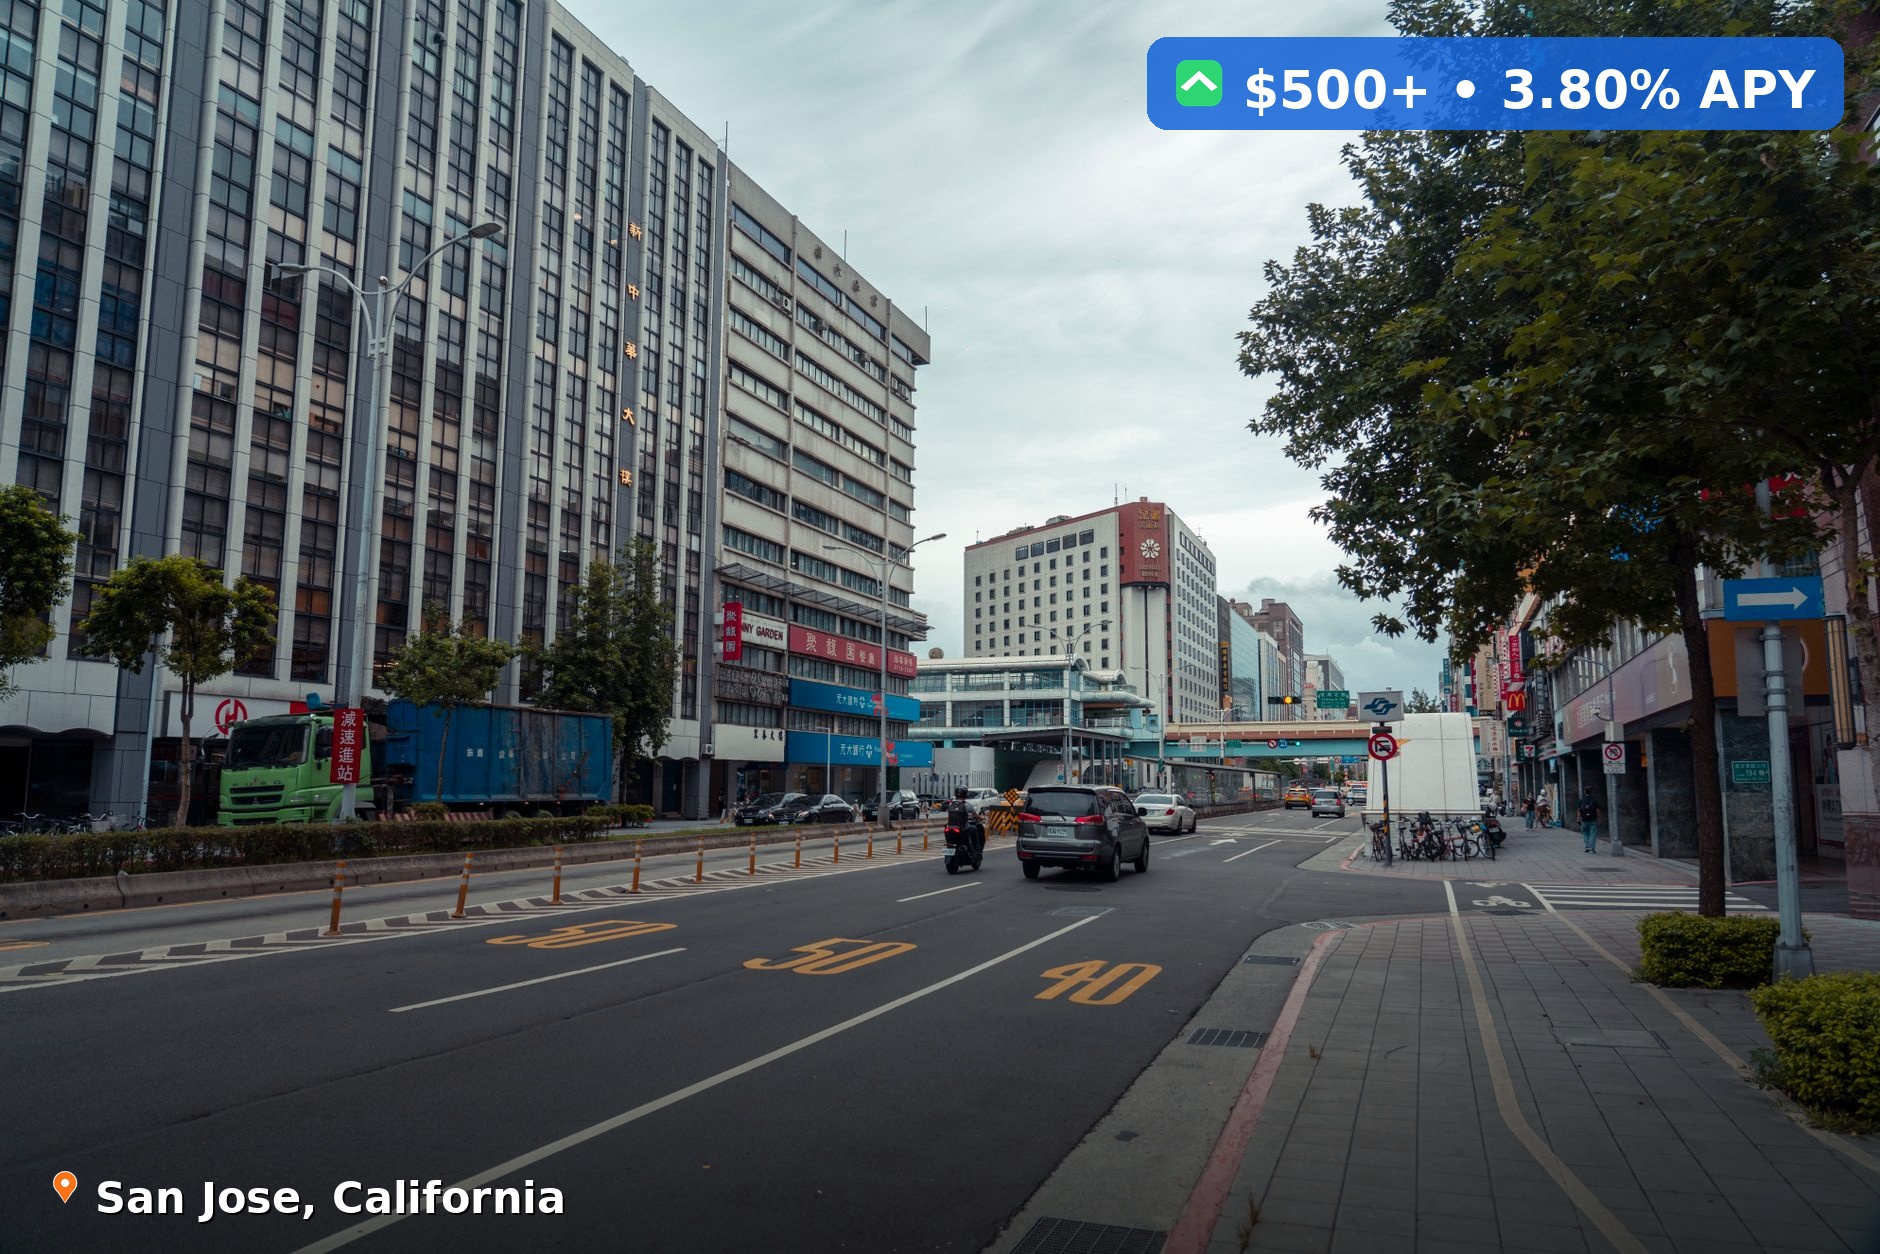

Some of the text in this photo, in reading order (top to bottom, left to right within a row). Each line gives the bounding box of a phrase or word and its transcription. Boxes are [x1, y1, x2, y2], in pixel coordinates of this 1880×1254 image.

[756, 625, 784, 641] GARDEN
[336, 711, 357, 783] 減速進站
[840, 743, 865, 757] 元大銀行
[485, 920, 678, 948] 50
[743, 938, 917, 975] 50
[1034, 960, 1162, 1005] 40
